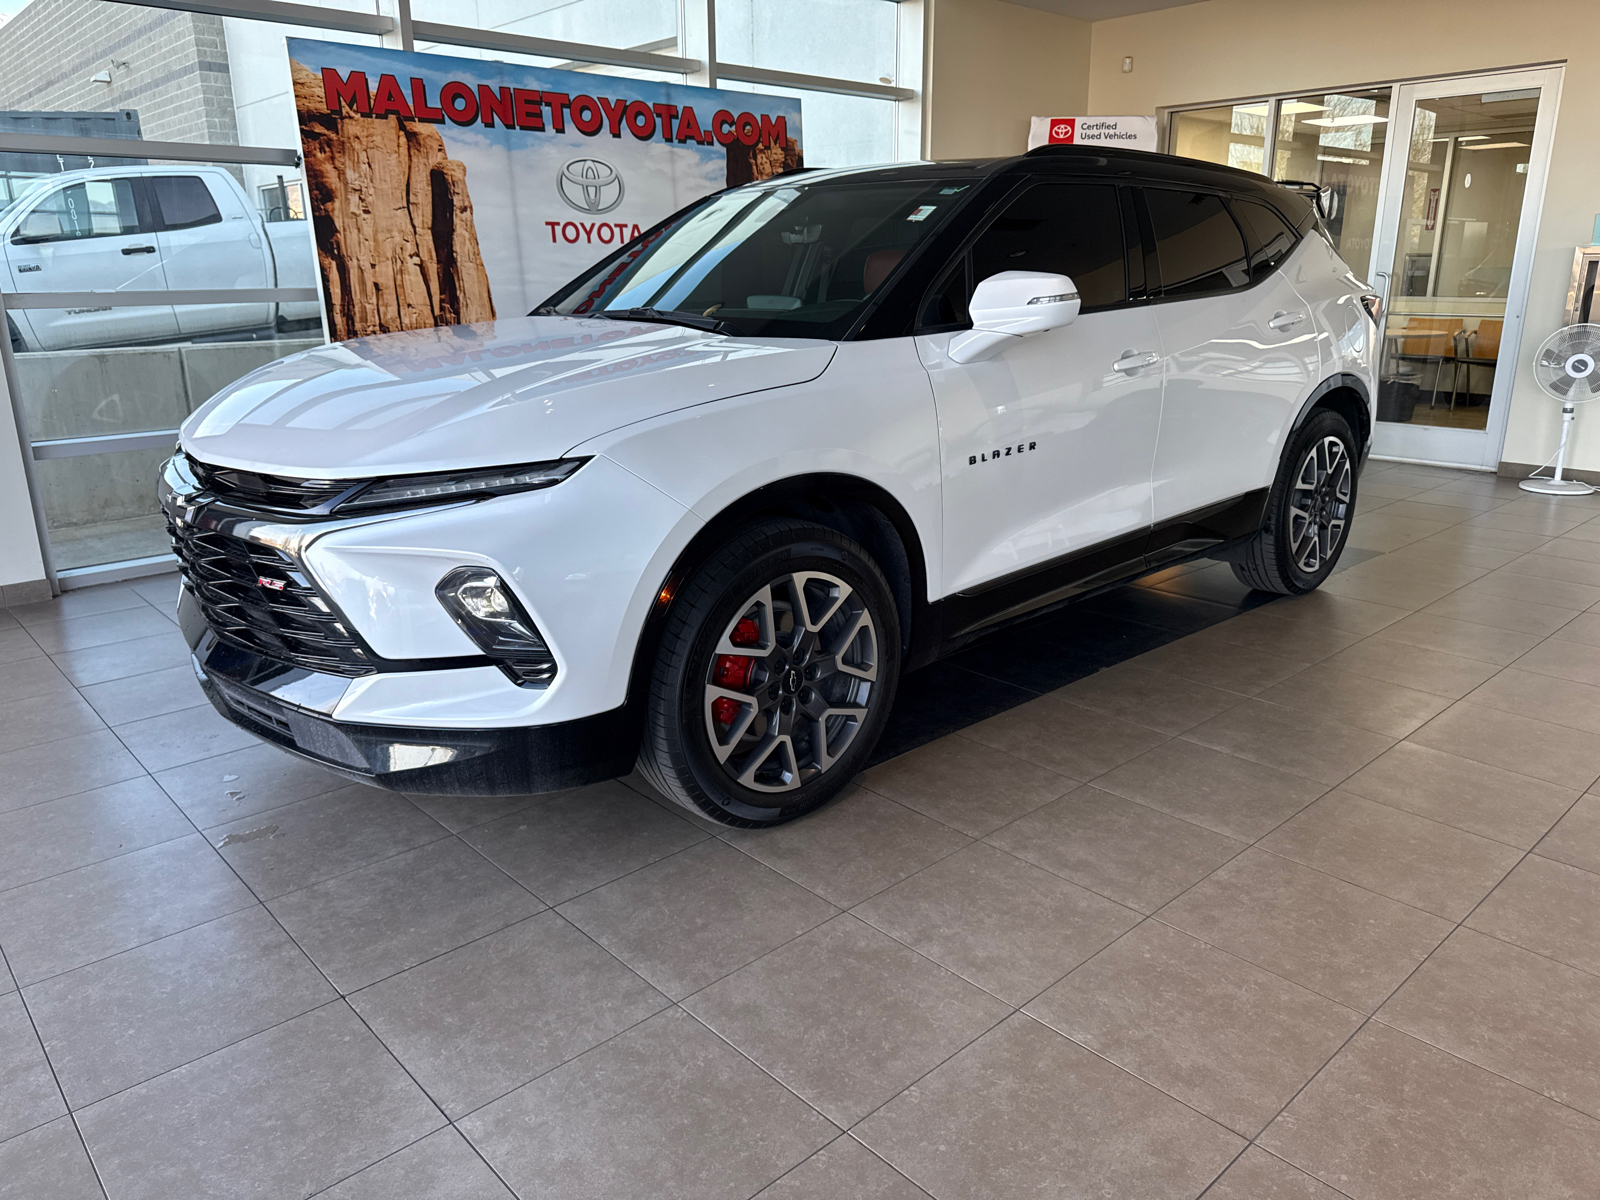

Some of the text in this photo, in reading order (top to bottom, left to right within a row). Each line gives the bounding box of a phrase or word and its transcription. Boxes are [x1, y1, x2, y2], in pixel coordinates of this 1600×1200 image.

[320, 67, 787, 149] MALONETOYOTA.COM
[1080, 122, 1118, 131] Certified
[1080, 131, 1138, 140] Used Vehicles
[544, 220, 642, 245] TOYOTA
[968, 441, 1037, 466] BLAZER
